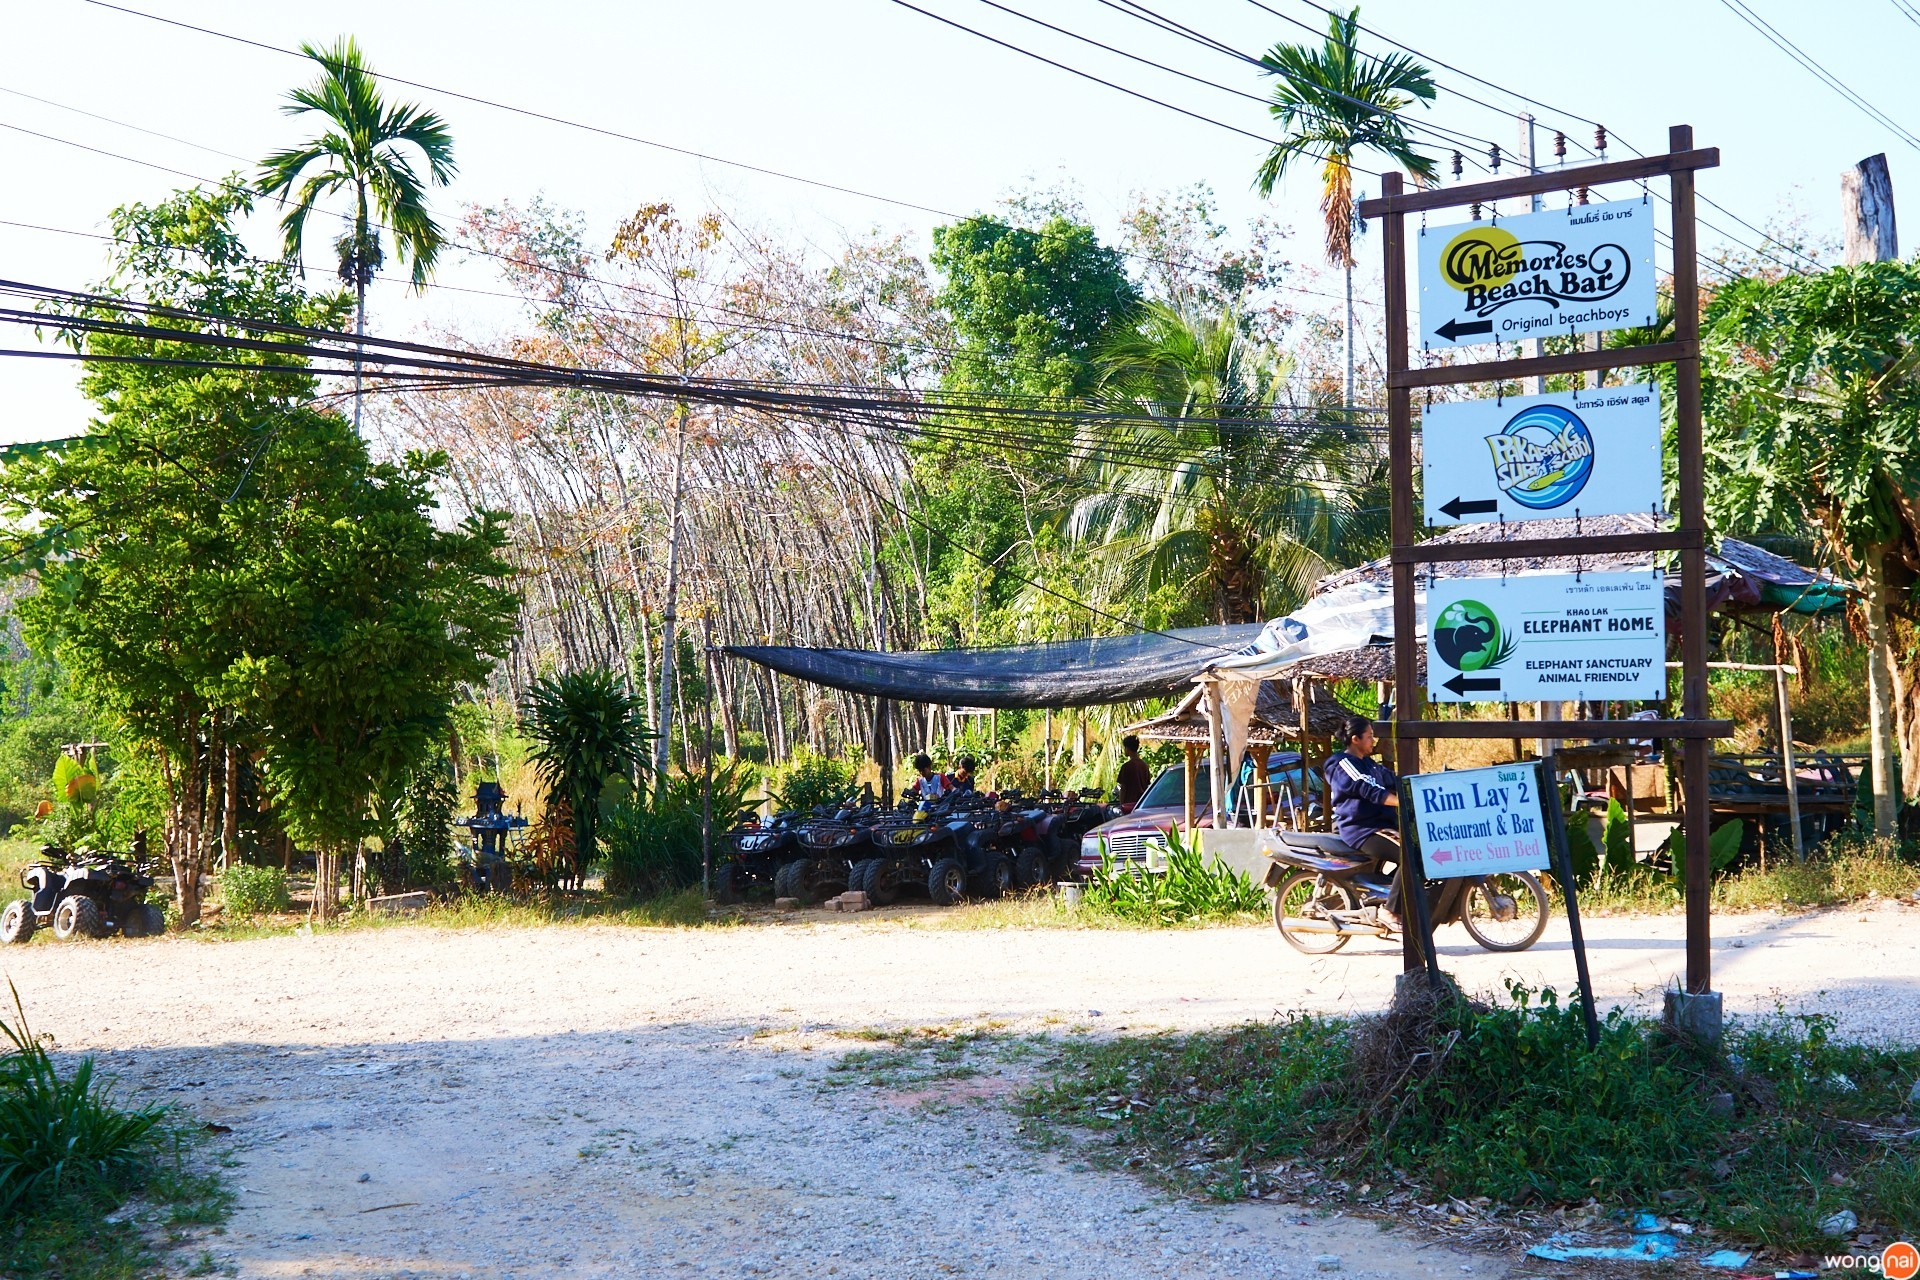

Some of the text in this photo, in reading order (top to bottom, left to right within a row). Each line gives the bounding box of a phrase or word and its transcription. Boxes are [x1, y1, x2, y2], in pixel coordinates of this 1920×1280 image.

[1616, 207, 1633, 219] บาร์
[1447, 240, 1588, 284] Memories
[1464, 261, 1625, 313] Beach Bar
[1502, 307, 1630, 333] Original beachboys
[1484, 420, 1582, 468] PAKARANG
[1566, 607, 1609, 617] KHAO LAK
[1523, 617, 1654, 634] ELEPHANT HOME
[1526, 658, 1652, 670] ELEPHANT SANCTUARY
[1538, 672, 1640, 683] ANIMAL FRIENDLY
[1520, 771, 1526, 781] 2
[1421, 782, 1530, 814] Rim Lay 2
[1426, 813, 1535, 843] Restaurant & Bar
[1455, 838, 1541, 862] Free Sun Bed
